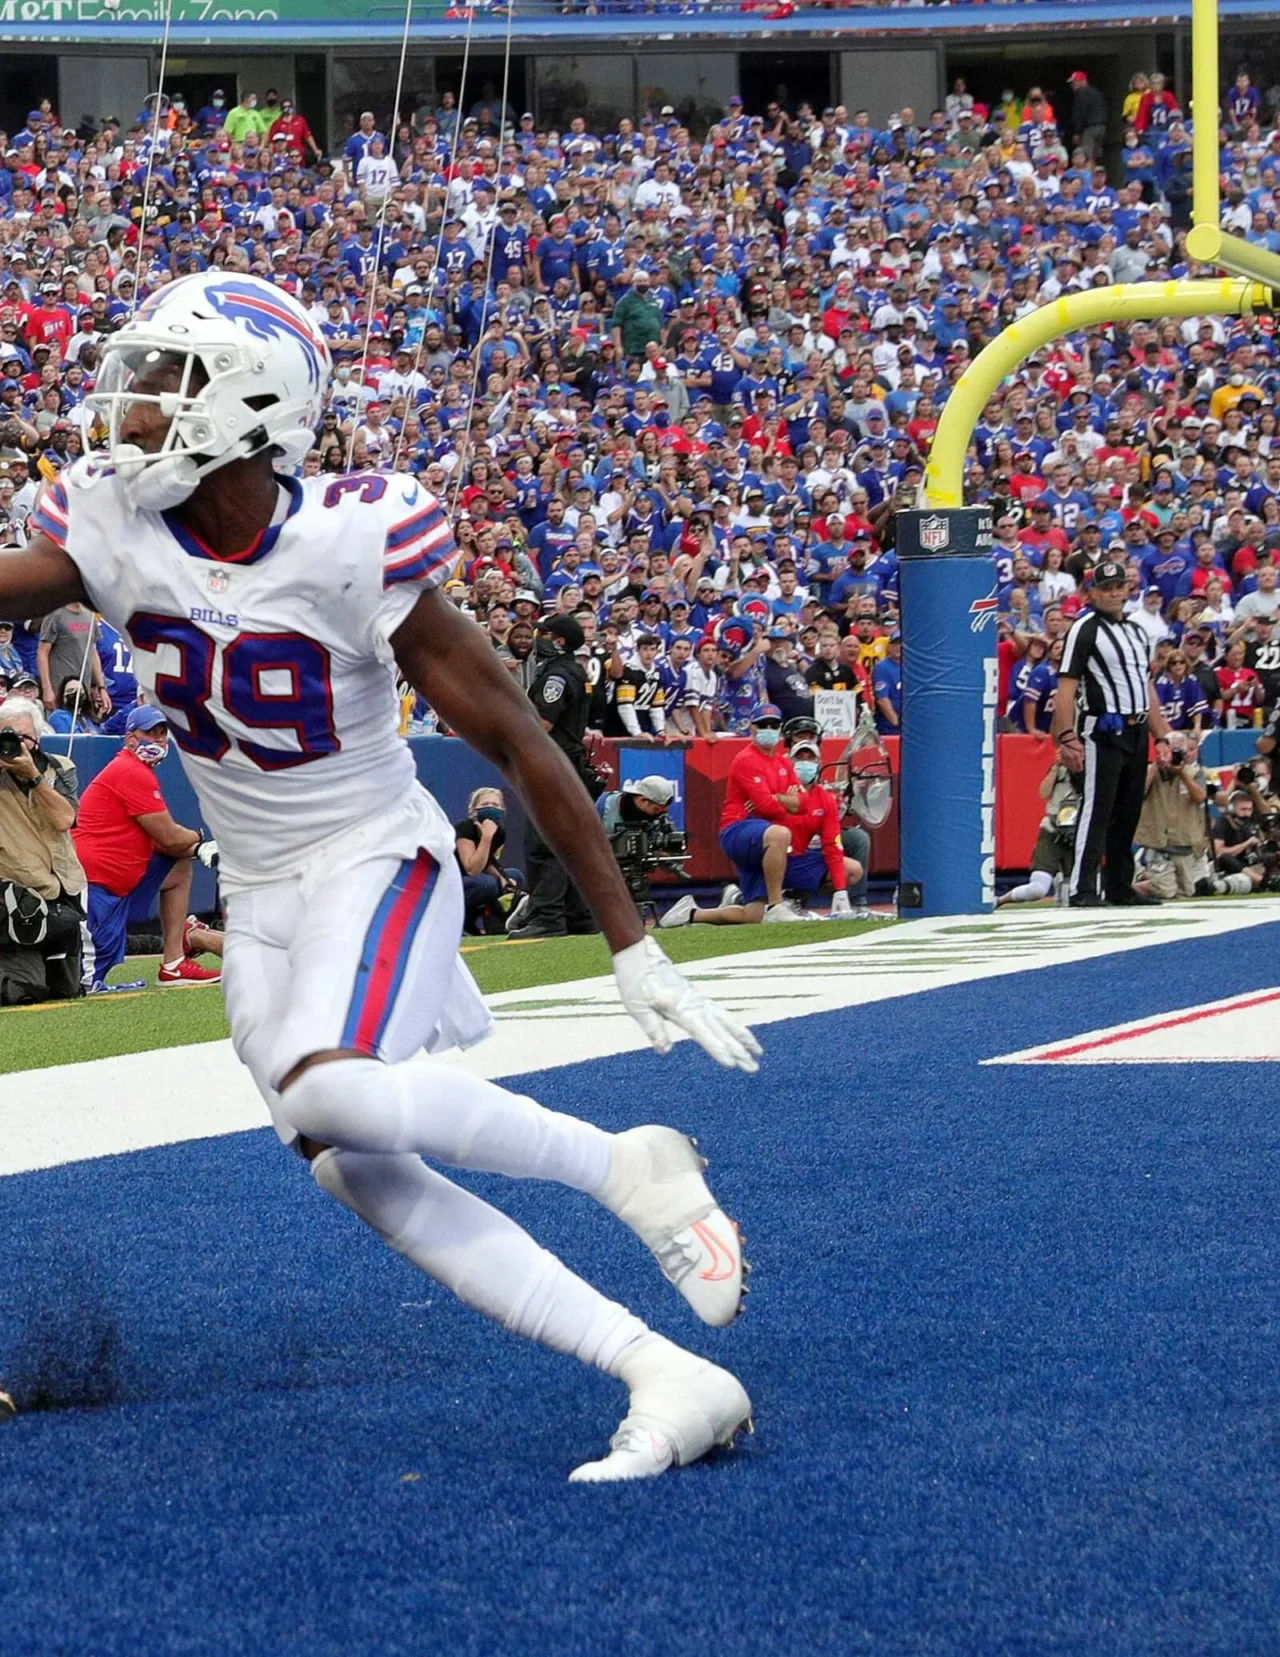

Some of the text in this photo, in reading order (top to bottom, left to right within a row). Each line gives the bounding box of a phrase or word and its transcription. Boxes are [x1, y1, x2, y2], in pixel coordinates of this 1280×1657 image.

[371, 169, 388, 185] 17
[359, 256, 376, 276] 17
[446, 250, 466, 268] 17
[1052, 502, 1081, 528] 12
[922, 529, 944, 544] NFL
[190, 607, 239, 627] BILLS
[125, 611, 341, 771] 39
